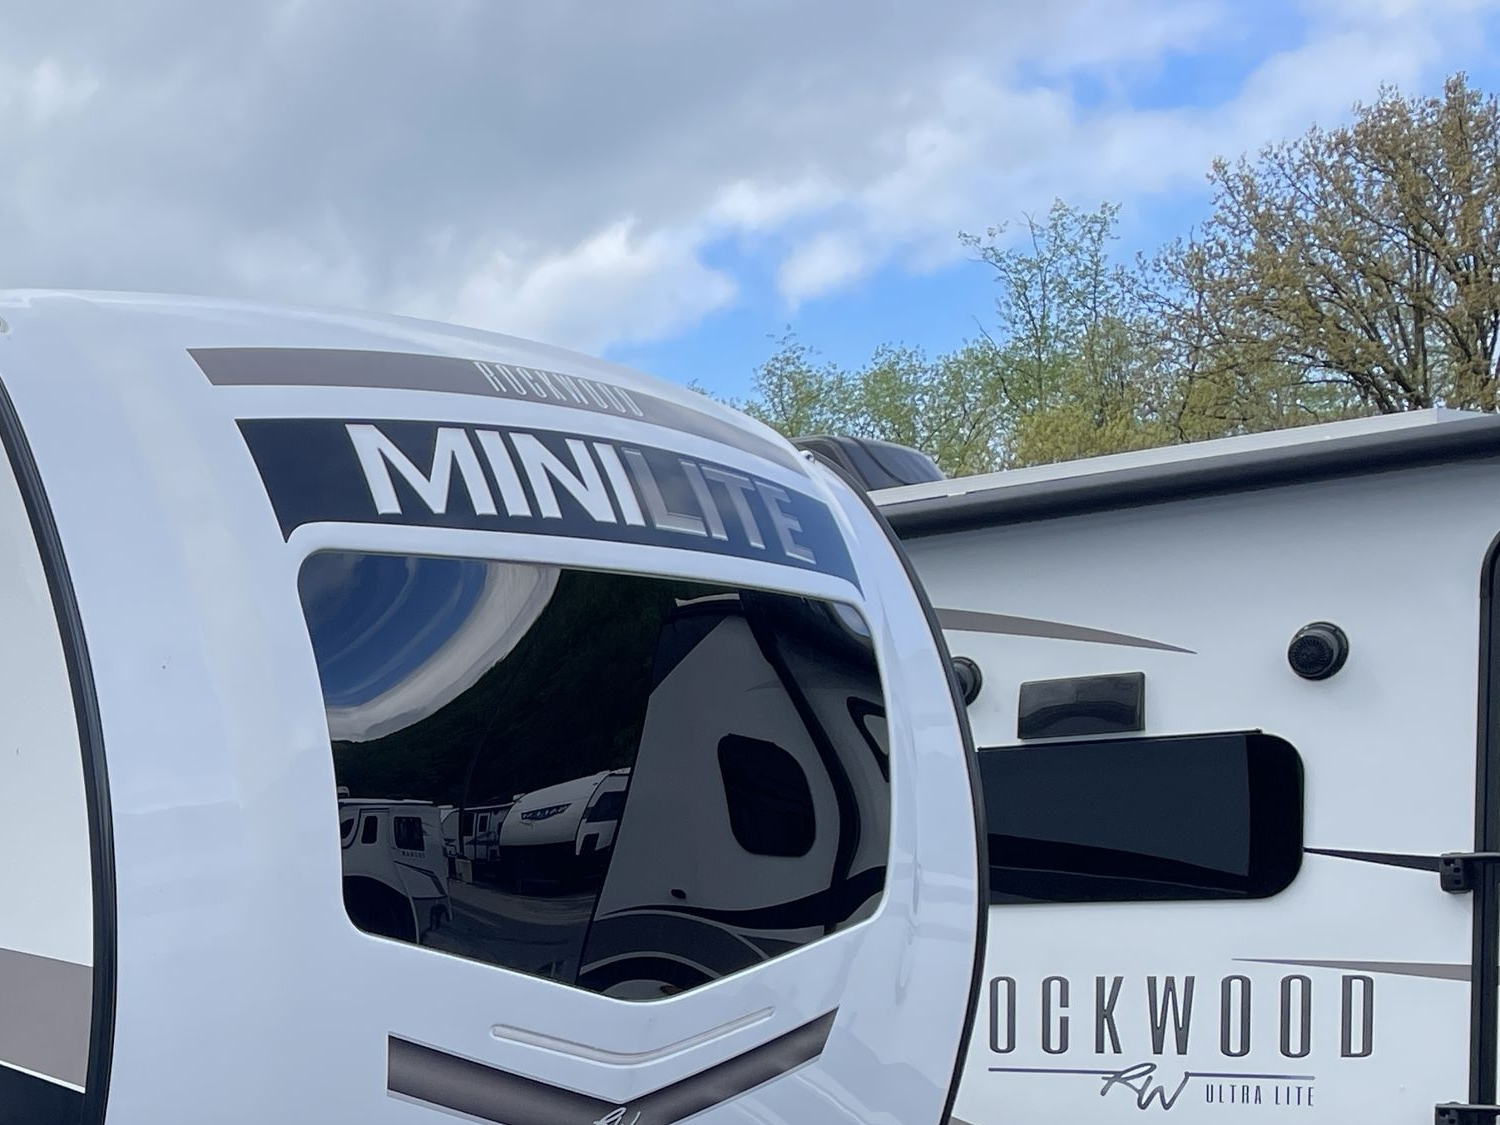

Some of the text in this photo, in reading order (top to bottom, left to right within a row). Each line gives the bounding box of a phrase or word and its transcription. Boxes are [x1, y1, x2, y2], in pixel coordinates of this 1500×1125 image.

[473, 360, 644, 417] ROCKWOOD
[344, 423, 817, 565] MINILITE
[989, 974, 1376, 1058] OCKWOOD
[1206, 1084, 1315, 1107] ULTRA LITE
